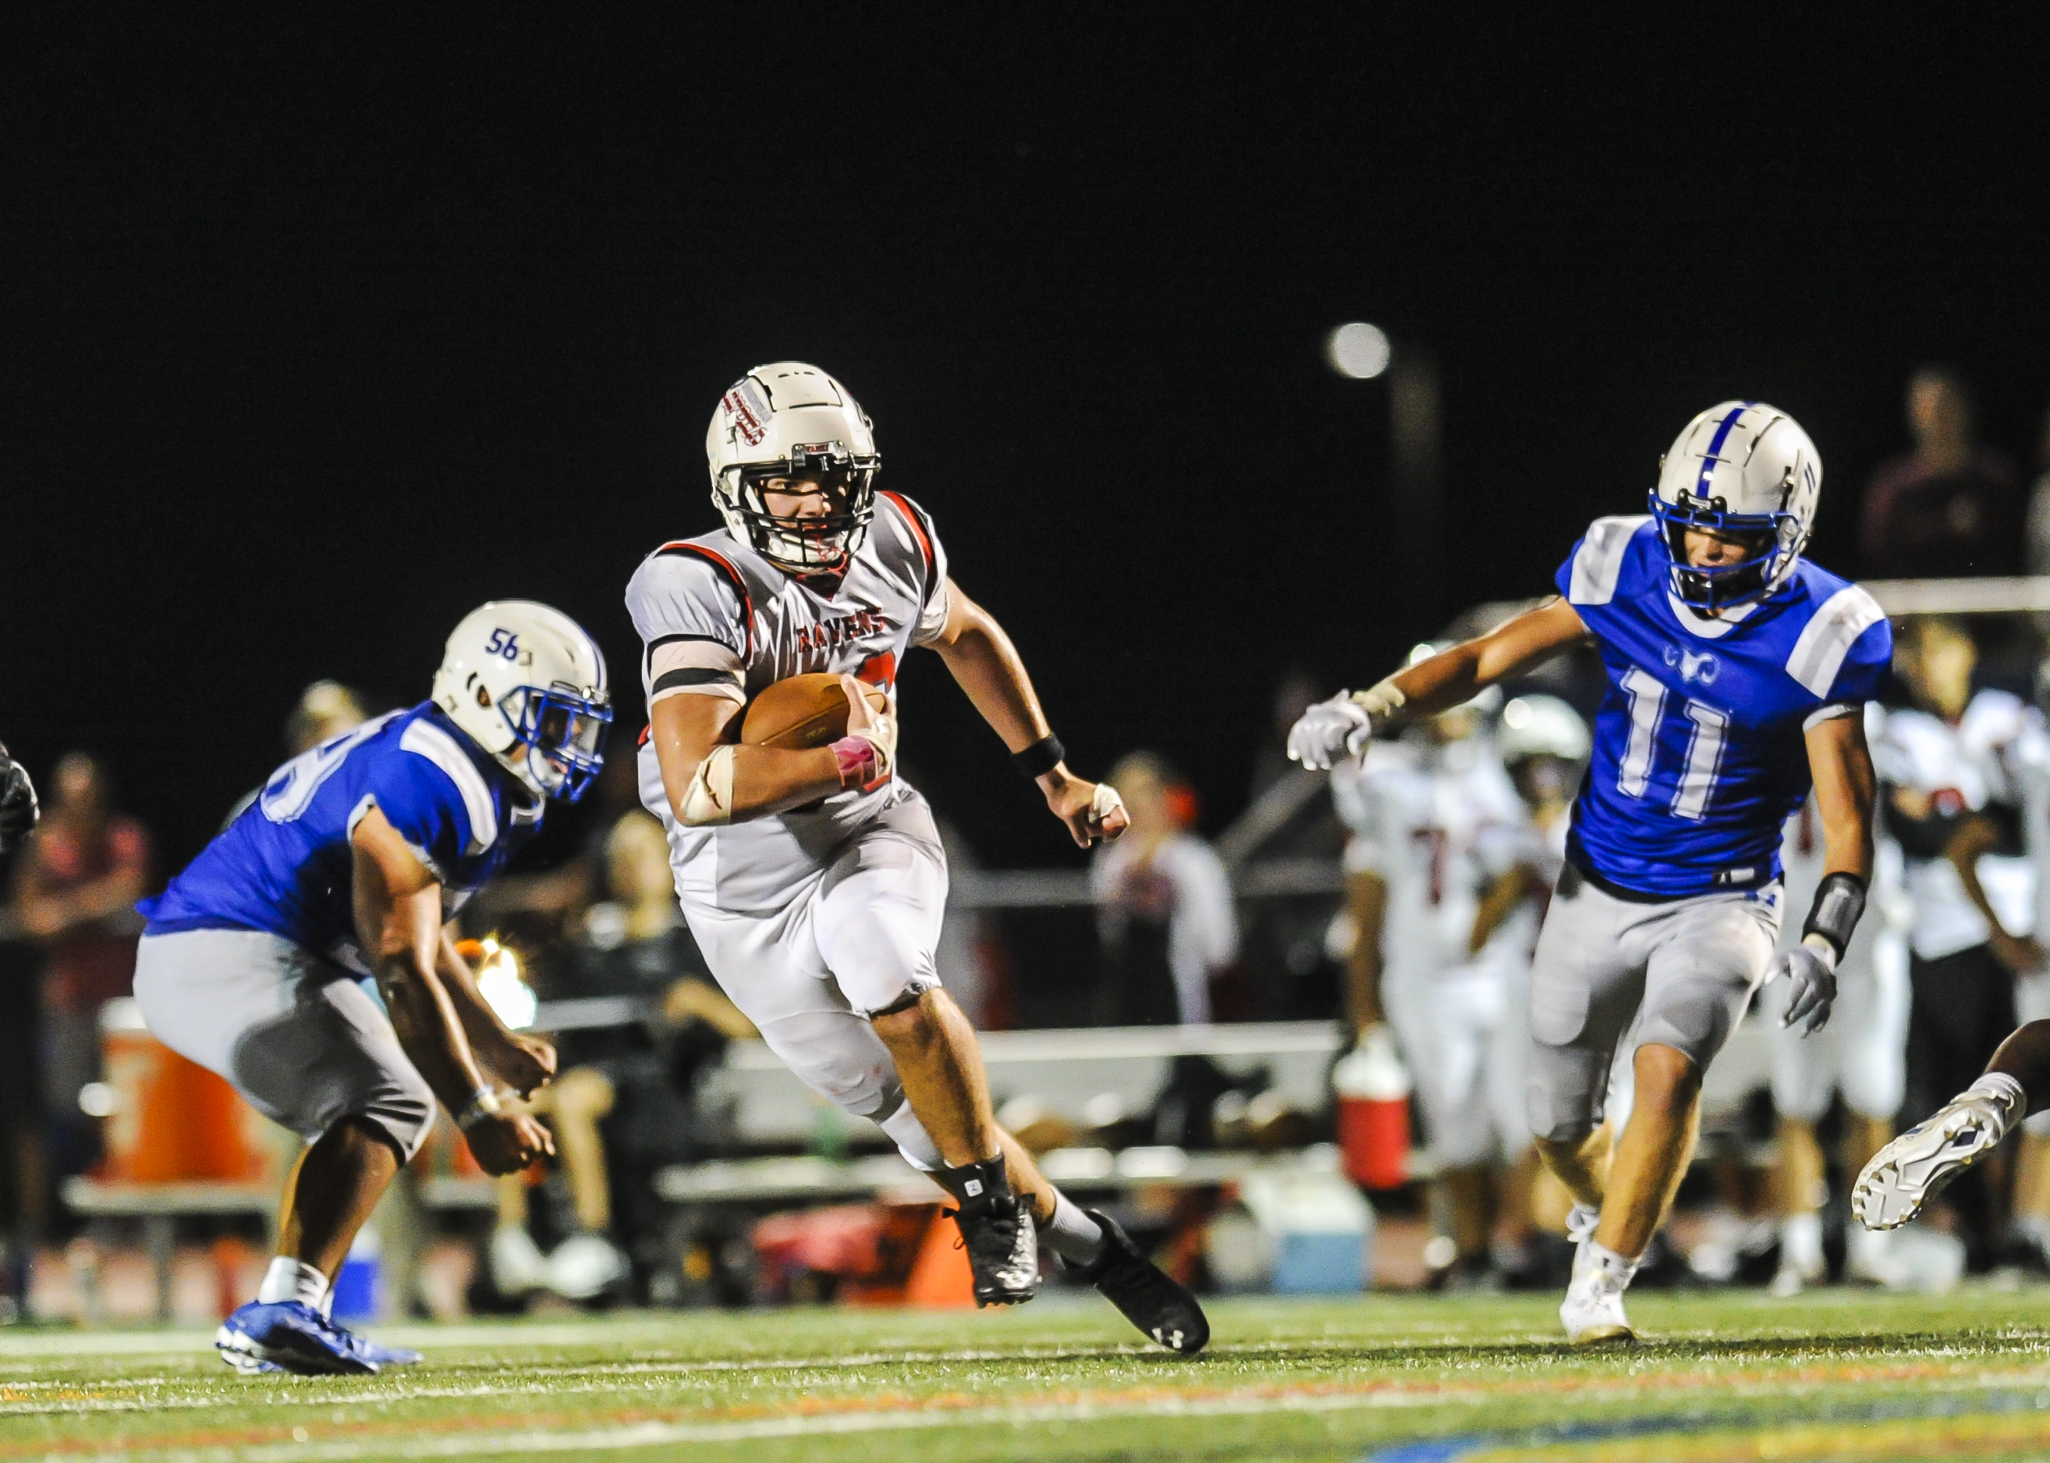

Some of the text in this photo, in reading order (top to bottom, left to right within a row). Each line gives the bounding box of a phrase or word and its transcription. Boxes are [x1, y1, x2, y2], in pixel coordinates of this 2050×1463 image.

[485, 627, 519, 662] 56
[796, 608, 885, 653] RAVENS
[1616, 664, 1731, 825] 11
